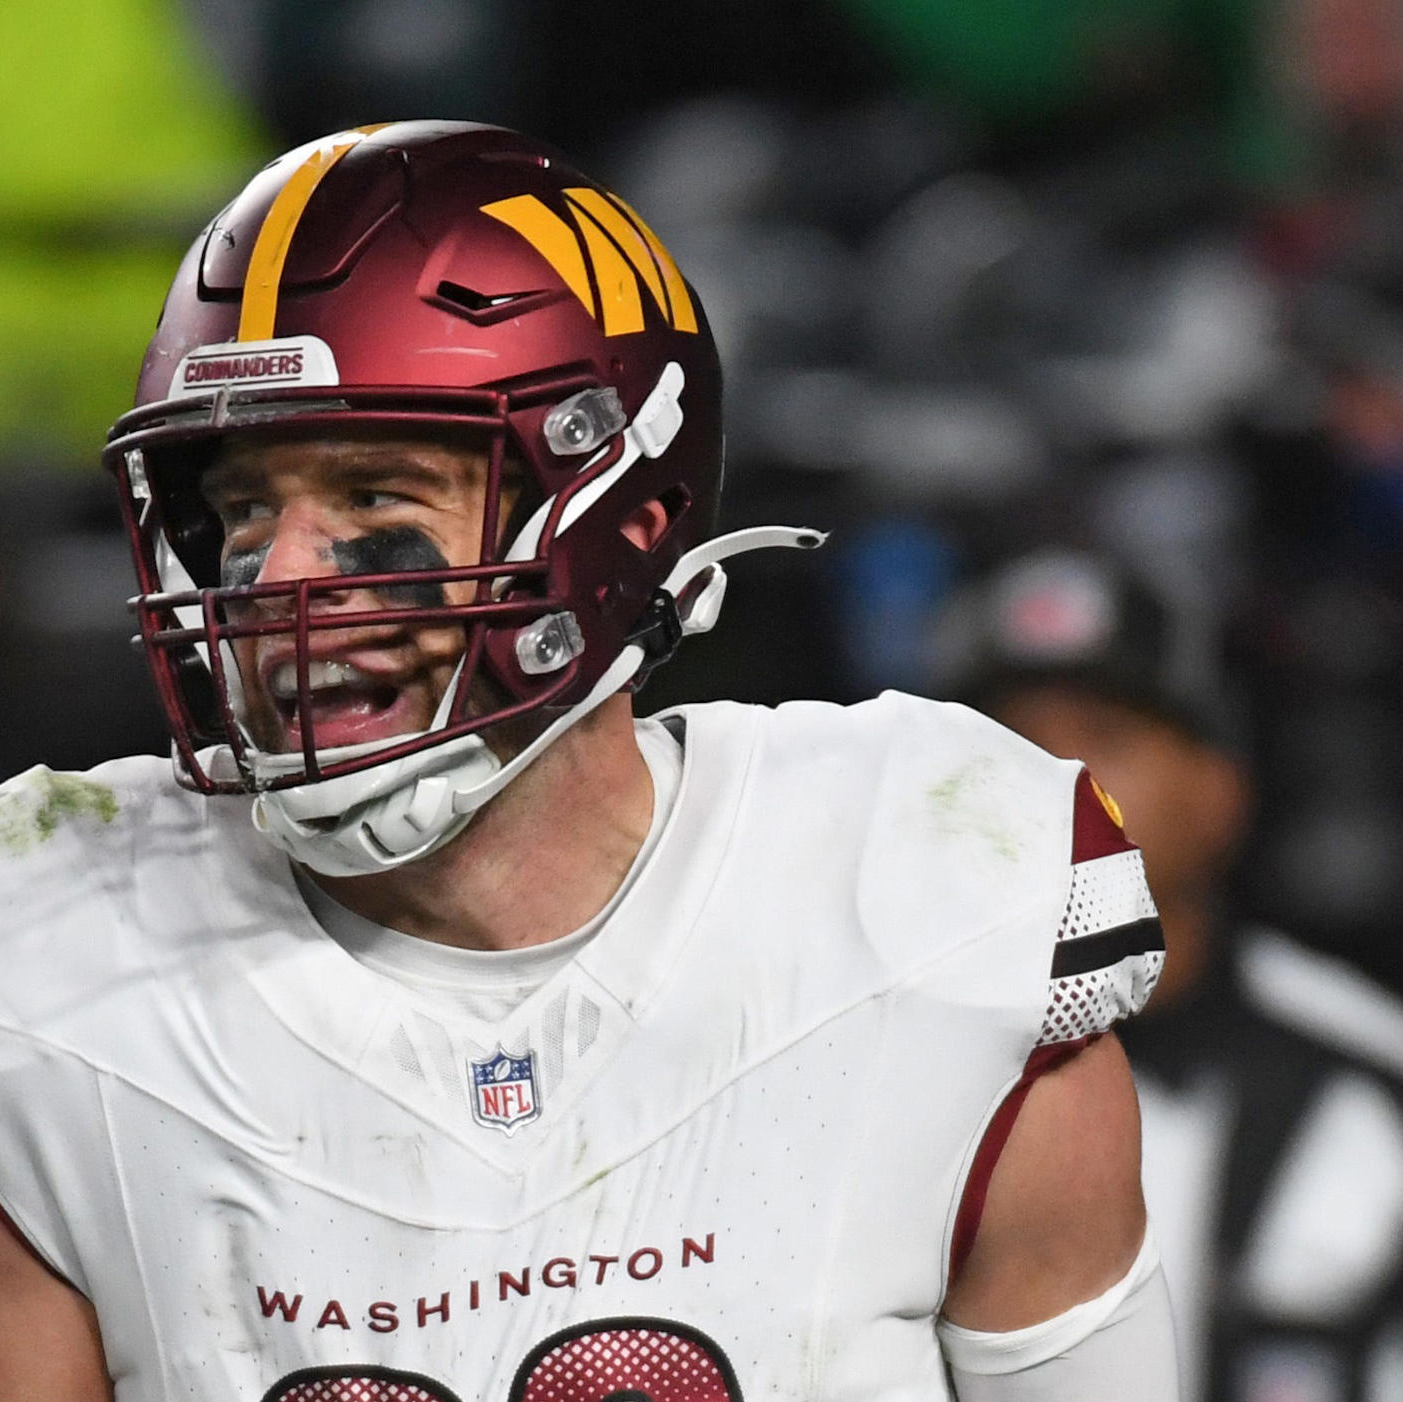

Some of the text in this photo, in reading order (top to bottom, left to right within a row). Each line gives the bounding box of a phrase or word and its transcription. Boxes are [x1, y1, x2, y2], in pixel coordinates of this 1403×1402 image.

[184, 353, 304, 383] COMMANDERS
[481, 1083, 531, 1119] NFL
[256, 1232, 716, 1333] WASHINGTON
